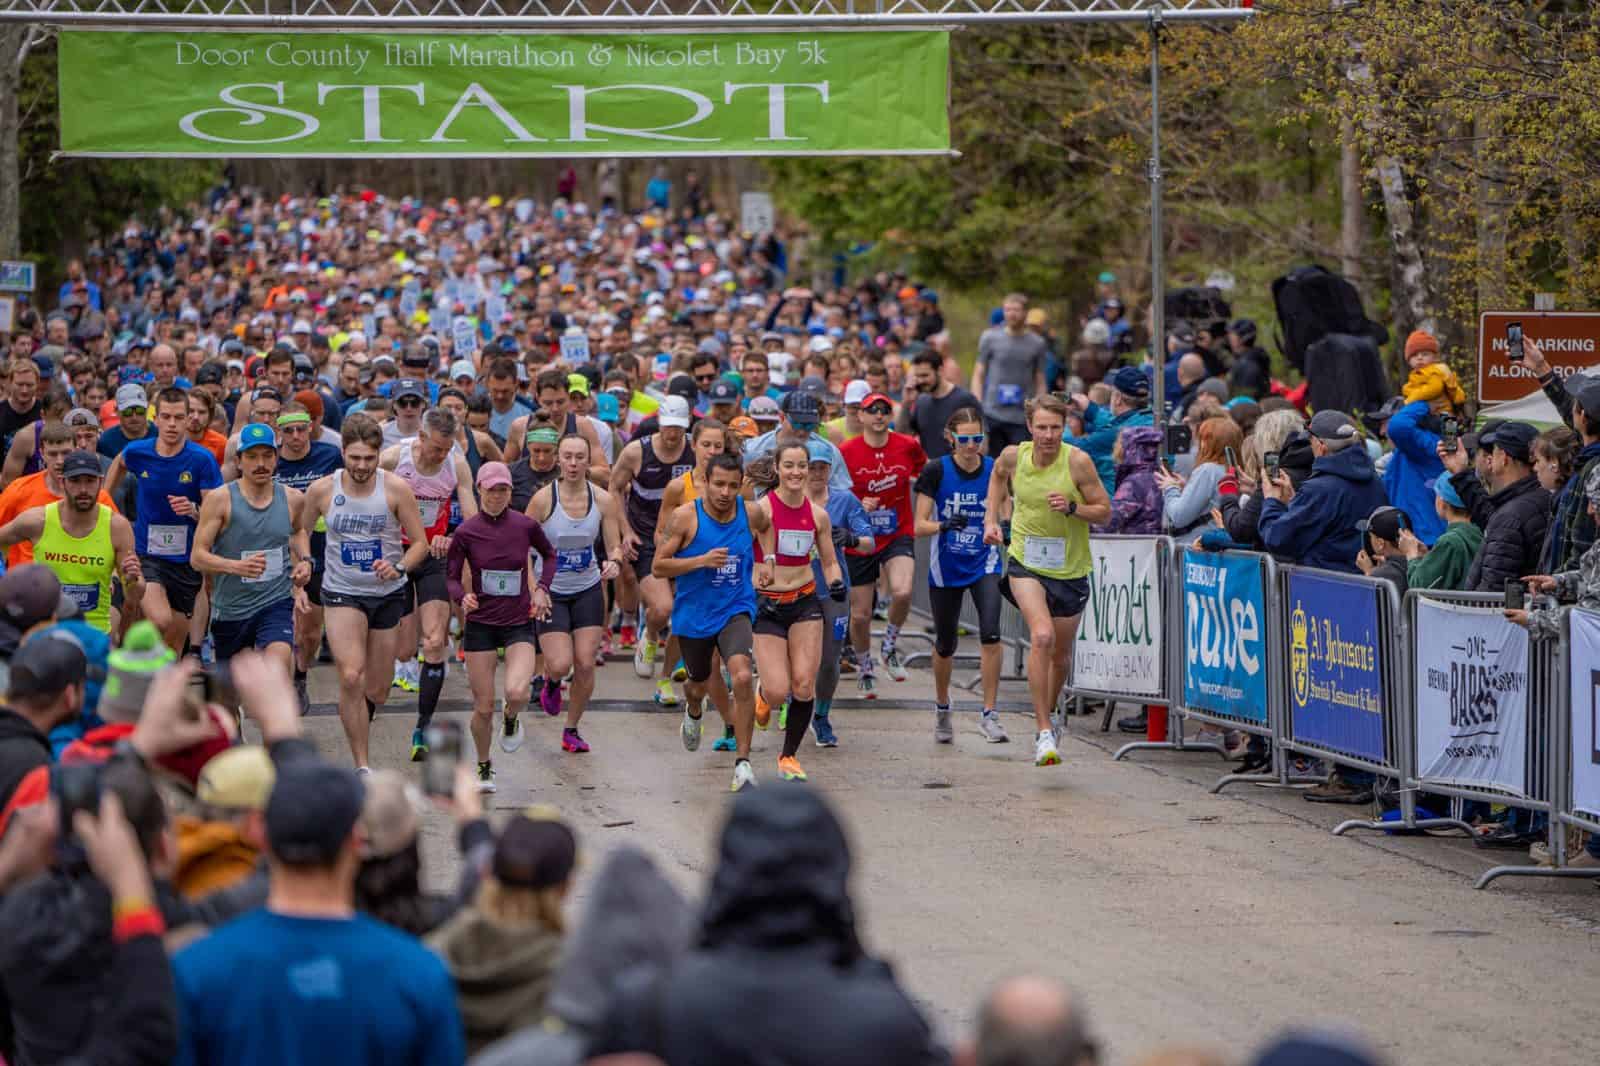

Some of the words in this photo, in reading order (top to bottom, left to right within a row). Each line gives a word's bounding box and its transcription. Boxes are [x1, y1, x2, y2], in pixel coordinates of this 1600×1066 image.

[175, 41, 254, 66] Door
[266, 41, 370, 75] County
[384, 40, 441, 67] Half
[448, 43, 575, 67] Marathon
[587, 43, 615, 66] &
[625, 41, 726, 67] Nicolet
[736, 41, 786, 73] Bay
[798, 40, 829, 65] 5k
[178, 80, 829, 144] START
[1535, 337, 1596, 352] ARKING
[1488, 365, 1540, 378] ALON
[163, 534, 175, 546] 12
[44, 551, 105, 566] WISCOTC
[1078, 554, 1153, 647] Nicolet
[1186, 567, 1260, 689] pulse
[1466, 635, 1487, 661] ONE
